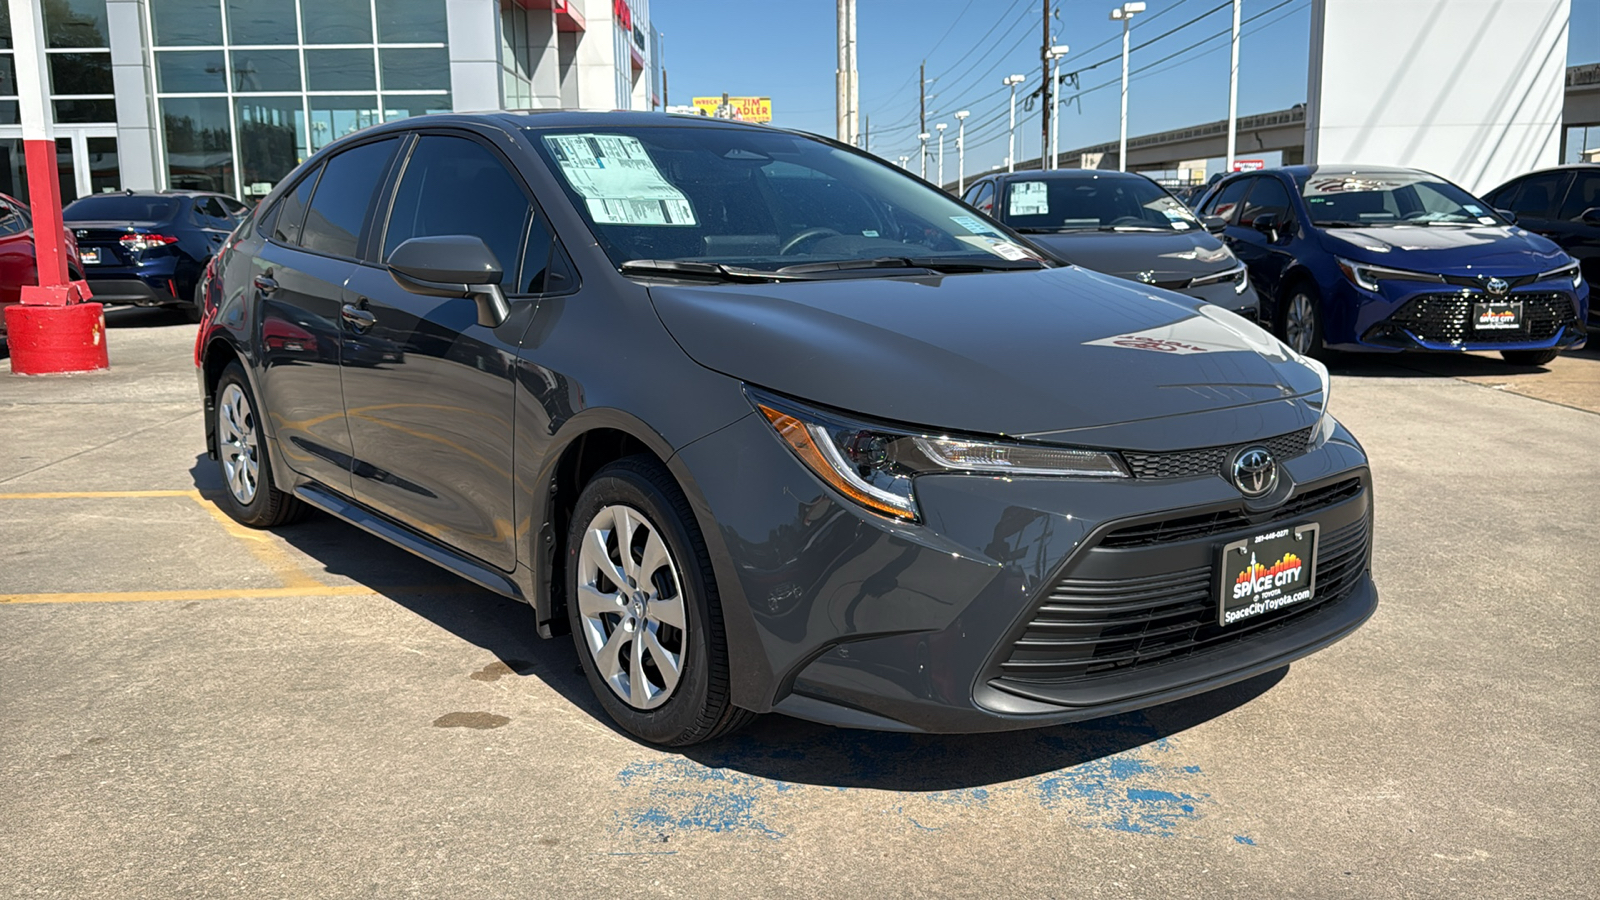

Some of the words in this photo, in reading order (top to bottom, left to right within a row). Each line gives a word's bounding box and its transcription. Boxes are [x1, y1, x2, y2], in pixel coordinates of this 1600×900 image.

[743, 99, 760, 107] JIM
[736, 107, 768, 116] ADLER
[1233, 573, 1273, 599] SPACE
[1274, 566, 1302, 586] CITY
[1261, 588, 1281, 599] TOYOTA
[1225, 589, 1310, 622] SpaceCityToyota.com
